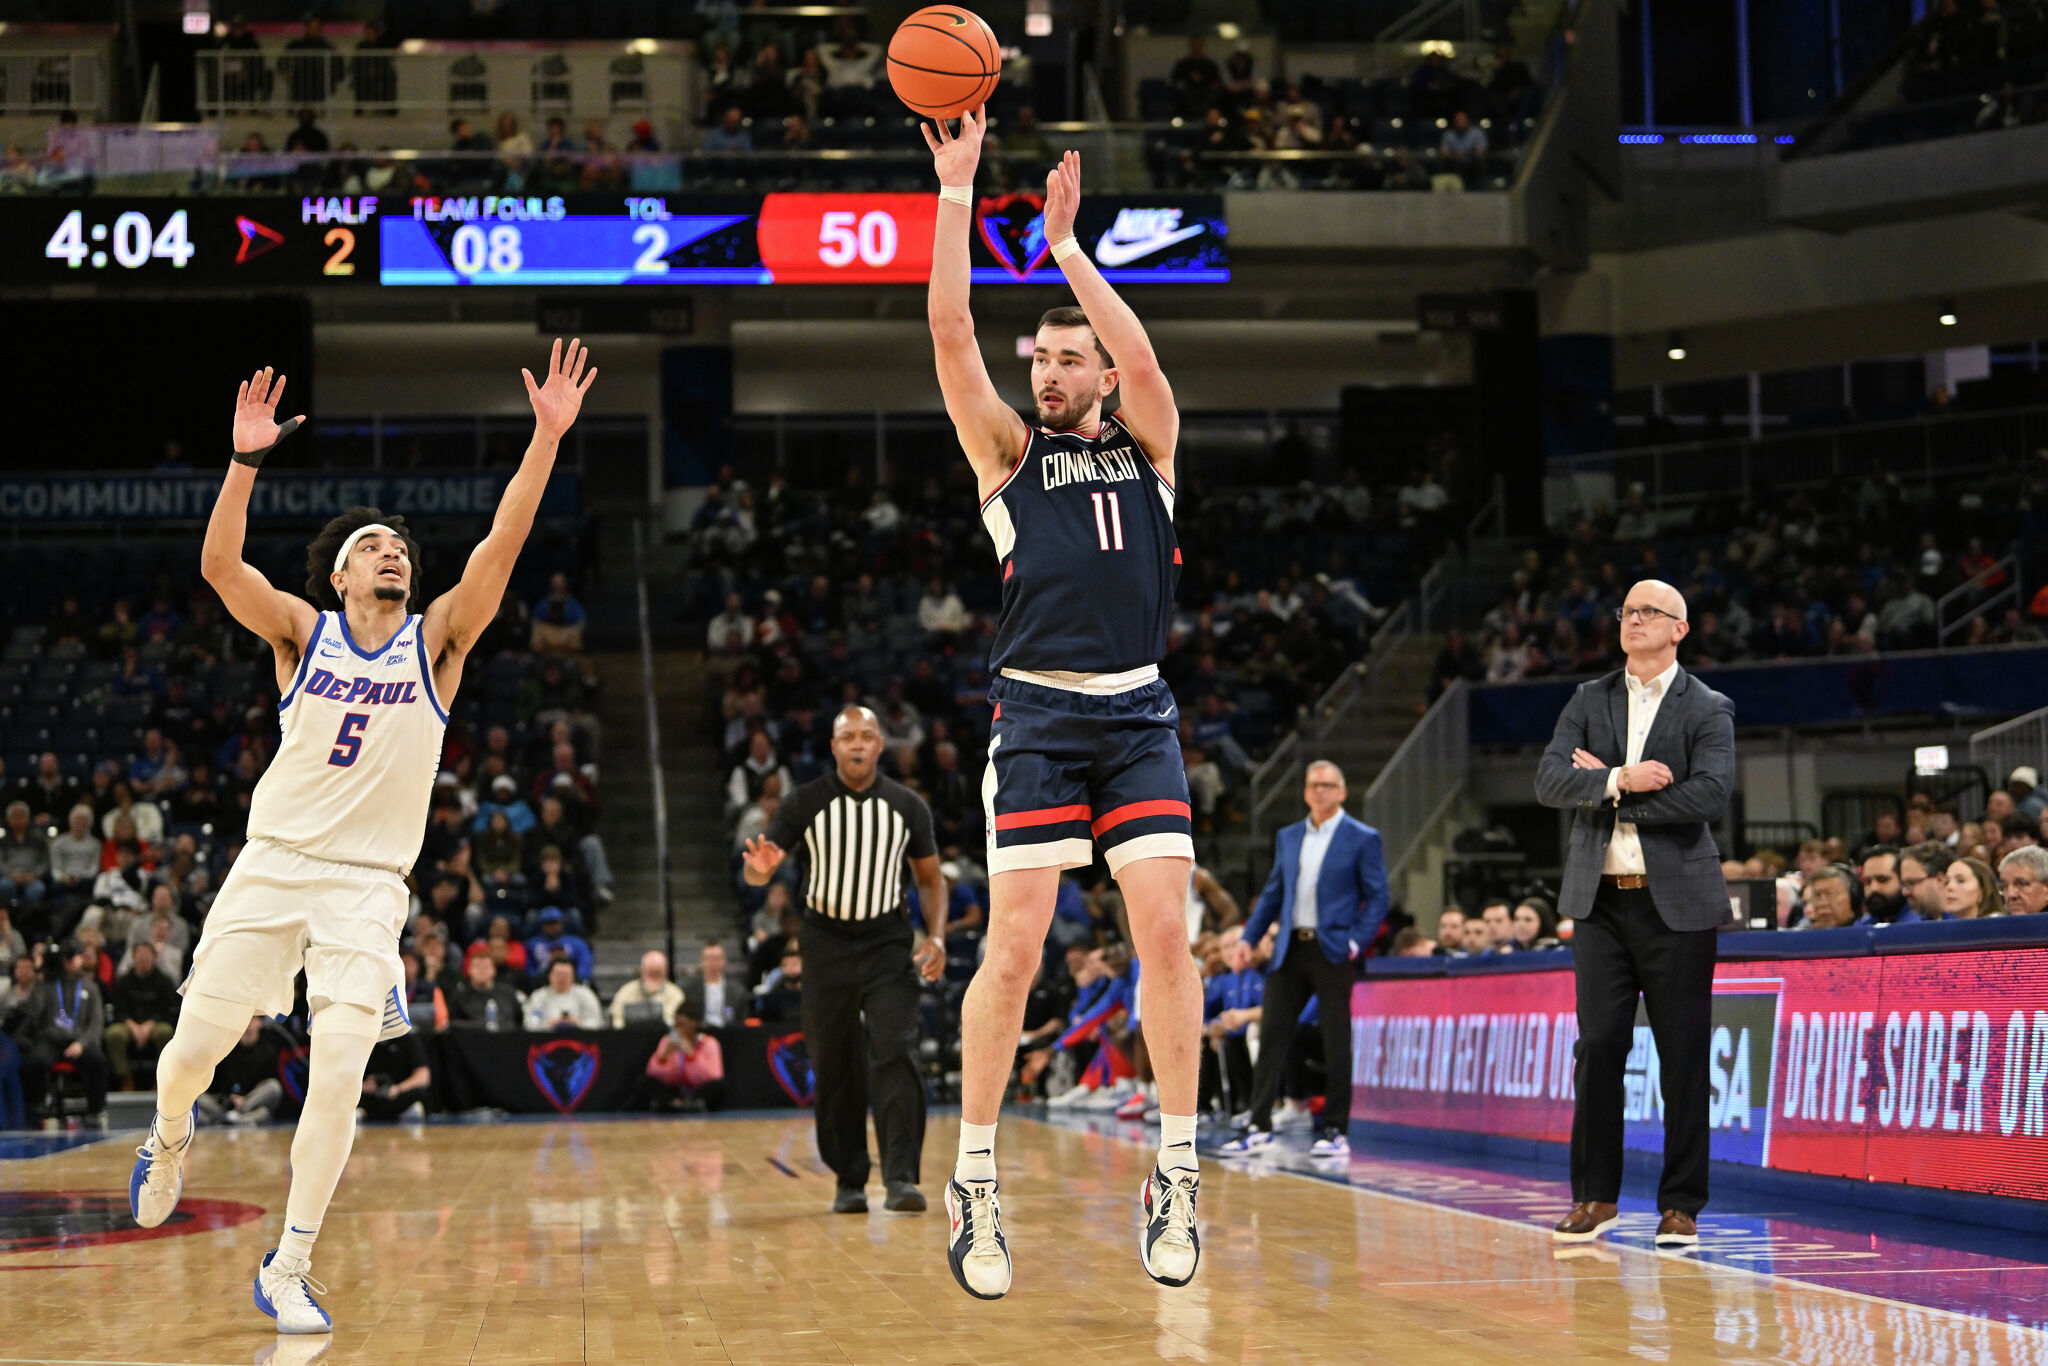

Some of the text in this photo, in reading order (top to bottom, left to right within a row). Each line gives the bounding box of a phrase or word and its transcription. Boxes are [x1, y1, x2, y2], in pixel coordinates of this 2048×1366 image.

[302, 196, 378, 225] HALF
[482, 196, 566, 221] FOULS
[624, 196, 673, 221] TOL
[45, 209, 195, 269] 4:04
[322, 227, 356, 276] 2
[450, 224, 524, 276] 08
[632, 223, 670, 275] 2
[818, 210, 898, 268] 50
[0, 478, 497, 514] COMMUNIT TICKET ZONE
[1091, 491, 1124, 551] 11
[327, 712, 371, 767] 5
[1382, 1014, 1431, 1090] SOBER
[1452, 1013, 1487, 1093] GET
[1483, 1012, 1549, 1098] PULLED
[1783, 1010, 2048, 1136] DRIVE SOBER OR
